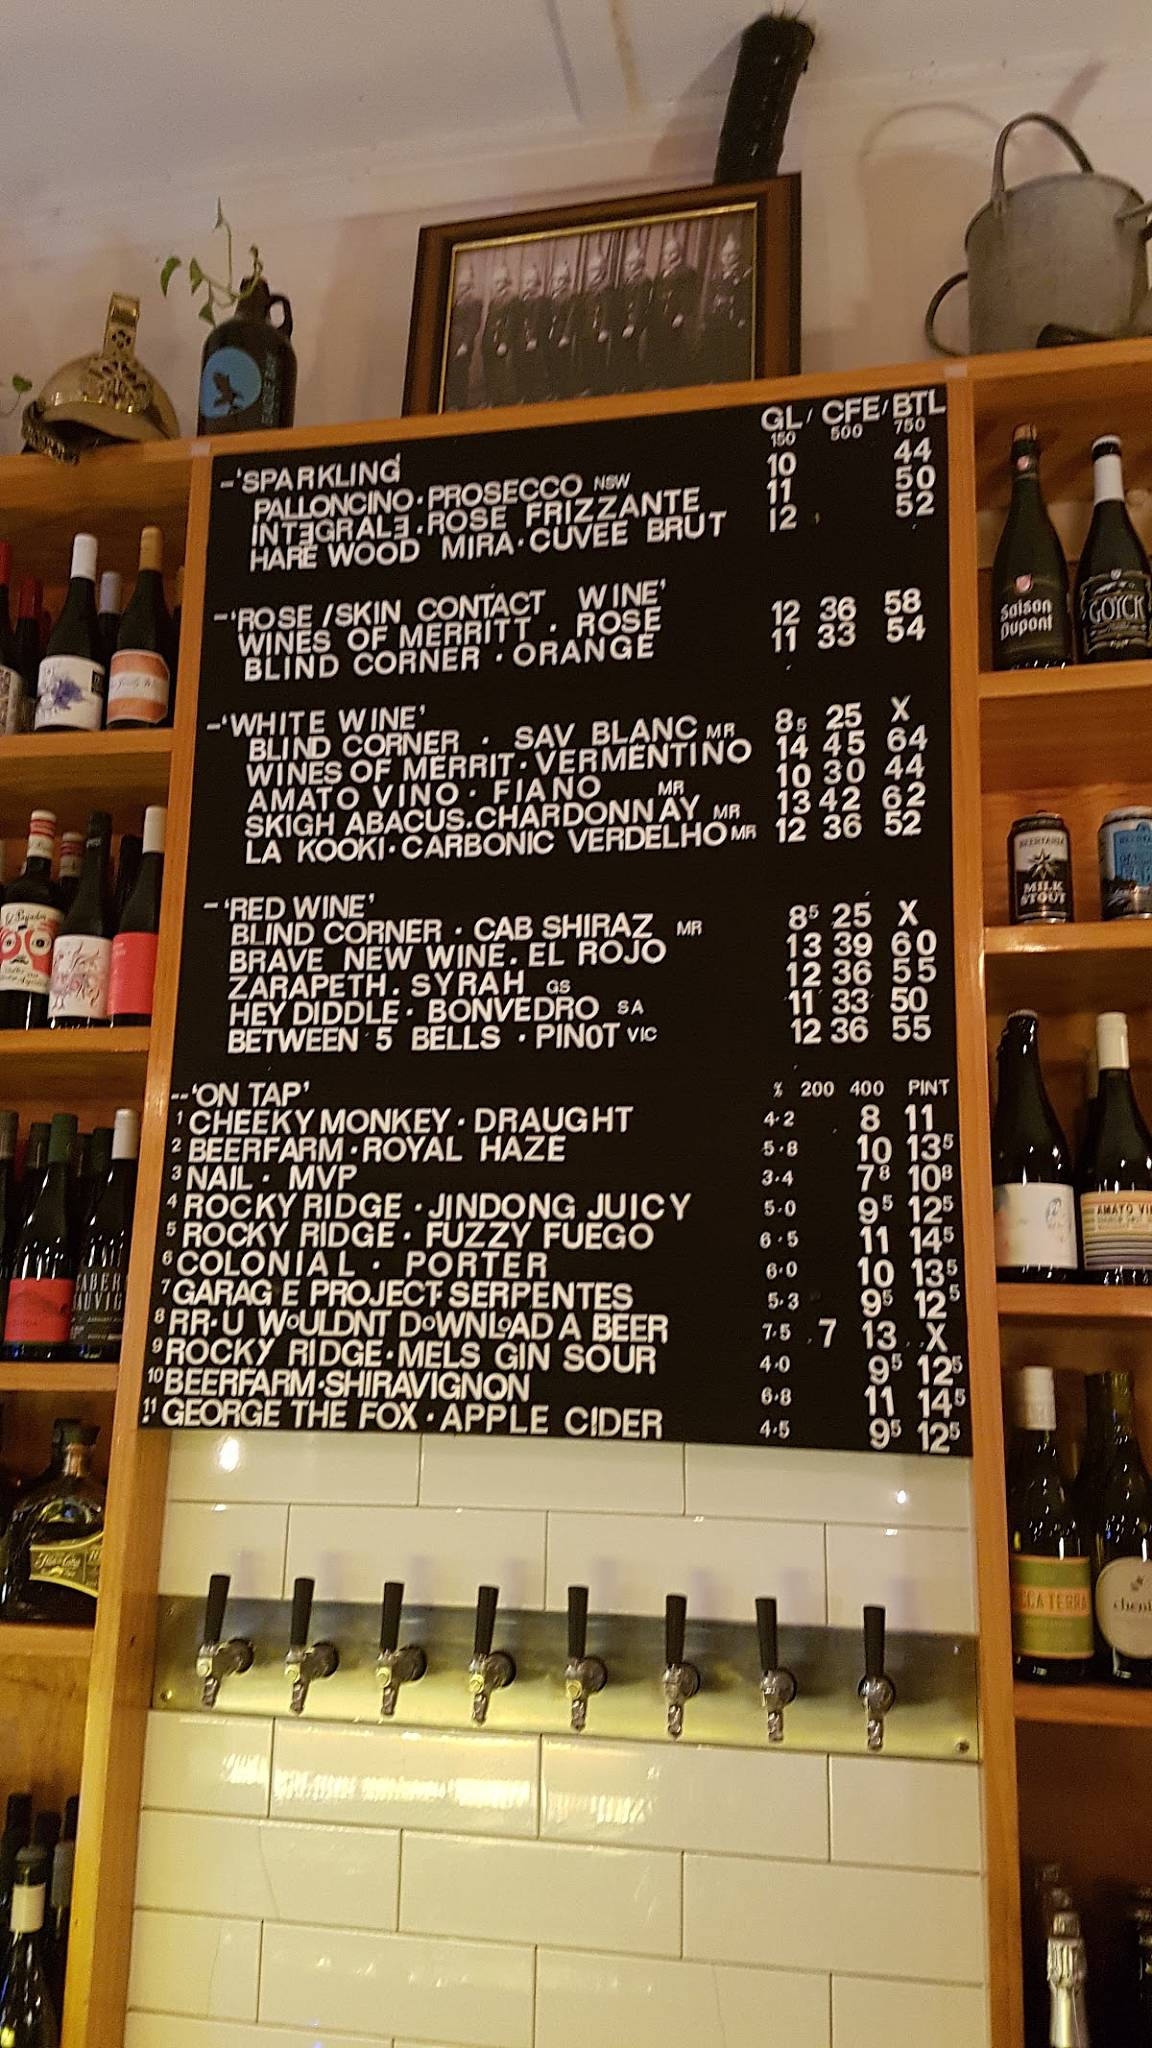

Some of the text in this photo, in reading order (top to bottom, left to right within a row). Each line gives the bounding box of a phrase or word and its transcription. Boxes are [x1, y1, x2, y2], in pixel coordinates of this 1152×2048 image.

[760, 389, 947, 432] GL CFE BTL
[770, 418, 926, 447] 150 500 750
[253, 437, 932, 522] PALLONCINO PROSECCO NSW 10 44
[428, 506, 506, 536] ROSE
[525, 486, 700, 528] FRIZZANTE
[766, 477, 791, 505] 11
[895, 465, 936, 490] 50
[249, 491, 934, 572] HARE WOOD MIRA CUVEE BRUT 12 52
[238, 588, 922, 657] WINES OF MERRITT ROSE 12 58
[417, 589, 546, 622] CONTACT
[245, 615, 926, 682] BLIND CORNER ORANGE 11 54
[248, 695, 911, 762] BLIND CORNER SAV BLANC MR X
[246, 724, 928, 787] WINES OF MERRIT VERMENTINO 14 64
[248, 753, 924, 813] AMATO VINO FIANO MR 10 44
[245, 782, 926, 838] SKIGH ABACUS CHARDONNAY MR 13 62
[246, 809, 922, 864] LA KOOKI CARBONIC VERDELHO MR 12 52
[1023, 880, 1063, 894] MILK
[231, 899, 919, 947] BLIND CORNER CAB SHIRAZ MR X
[229, 929, 937, 974] BRAVE NEW WINE EL ROJO 13 60
[228, 973, 386, 1000] ZARAPETH
[411, 969, 524, 997] SYRAH
[892, 957, 937, 984] 55
[230, 986, 928, 1026] HEY DIDDLE BONVEDRO SA 50
[228, 1028, 358, 1054] BETWEEN
[376, 1027, 392, 1052] 5
[411, 1024, 500, 1051] BELLS
[627, 1026, 658, 1043] VIC
[791, 1018, 822, 1045] 12
[892, 1015, 931, 1042] 55
[801, 1079, 949, 1097] 200 400 PINT
[189, 1103, 933, 1135] CHEEKY MONKEY DRAUGHT 8 11
[188, 1135, 892, 1165] BEERFARM ROYAL HAZE 10
[186, 1165, 358, 1192] NAIL MVP
[183, 1193, 691, 1221] ROCKY RIDGE JINDONG JUICY
[182, 1221, 888, 1254] ROCKY RIDGE FUZZY FUEGO 11
[176, 1250, 894, 1286] COLONIAL PORTER 10
[173, 1279, 633, 1310] GARAGE PROJECT SERPENTES
[558, 1313, 837, 1348] A BEER 7
[165, 1337, 656, 1374] ROCKY RIDGE MELS GIN SOUR
[164, 1367, 894, 1416] BEERFARM SHIRAVIGNON 11
[161, 1400, 663, 1439] GEORGE THE FOX APPLE CIDER
